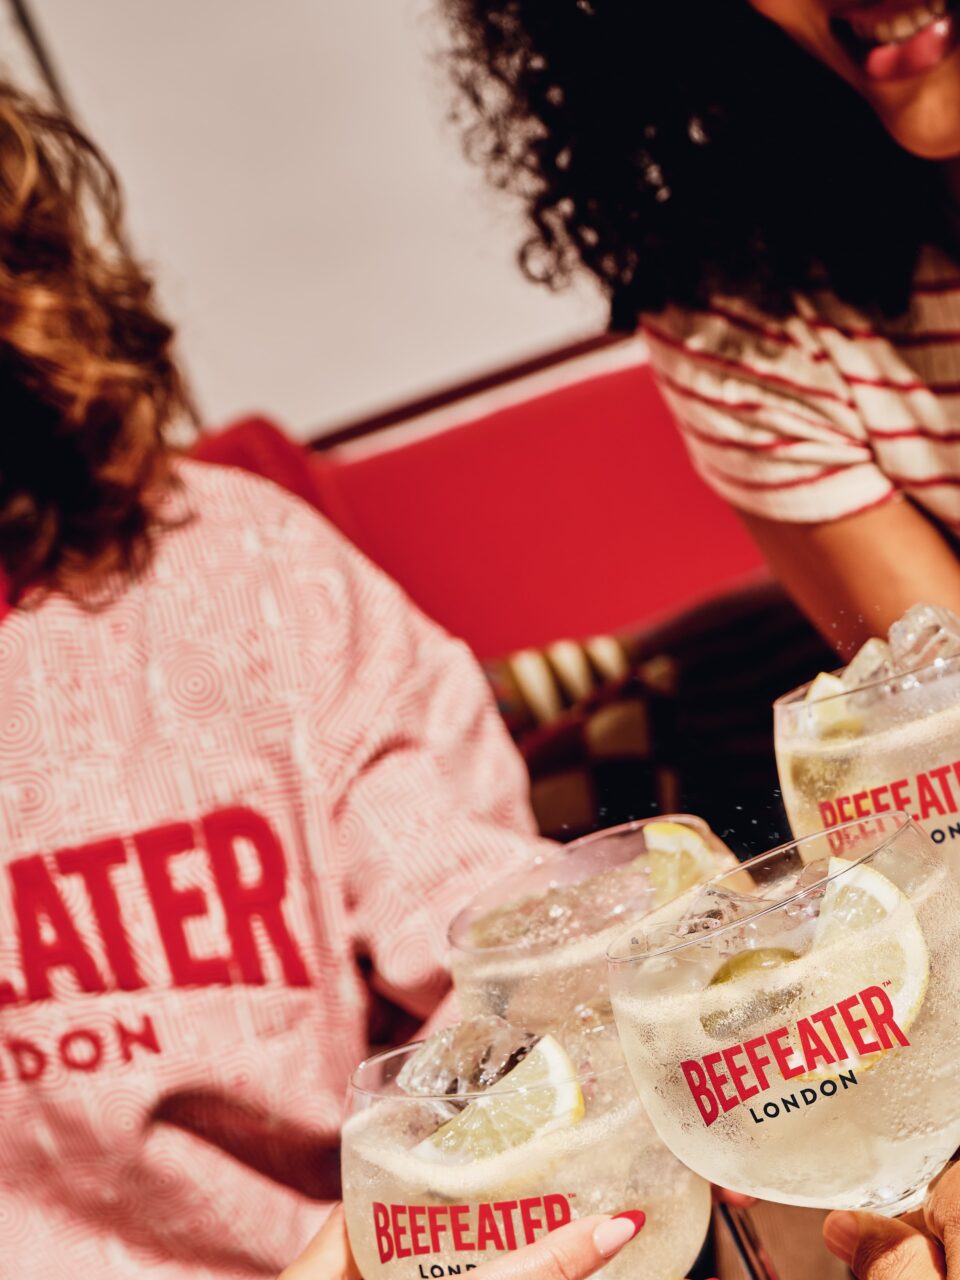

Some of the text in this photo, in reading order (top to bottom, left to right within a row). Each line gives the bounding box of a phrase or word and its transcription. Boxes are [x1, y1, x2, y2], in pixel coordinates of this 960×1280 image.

[0, 805, 312, 1009] ATER
[0, 1014, 161, 1082] DON
[680, 985, 911, 1127] BEEFEATER
[750, 1069, 858, 1124] LONDON
